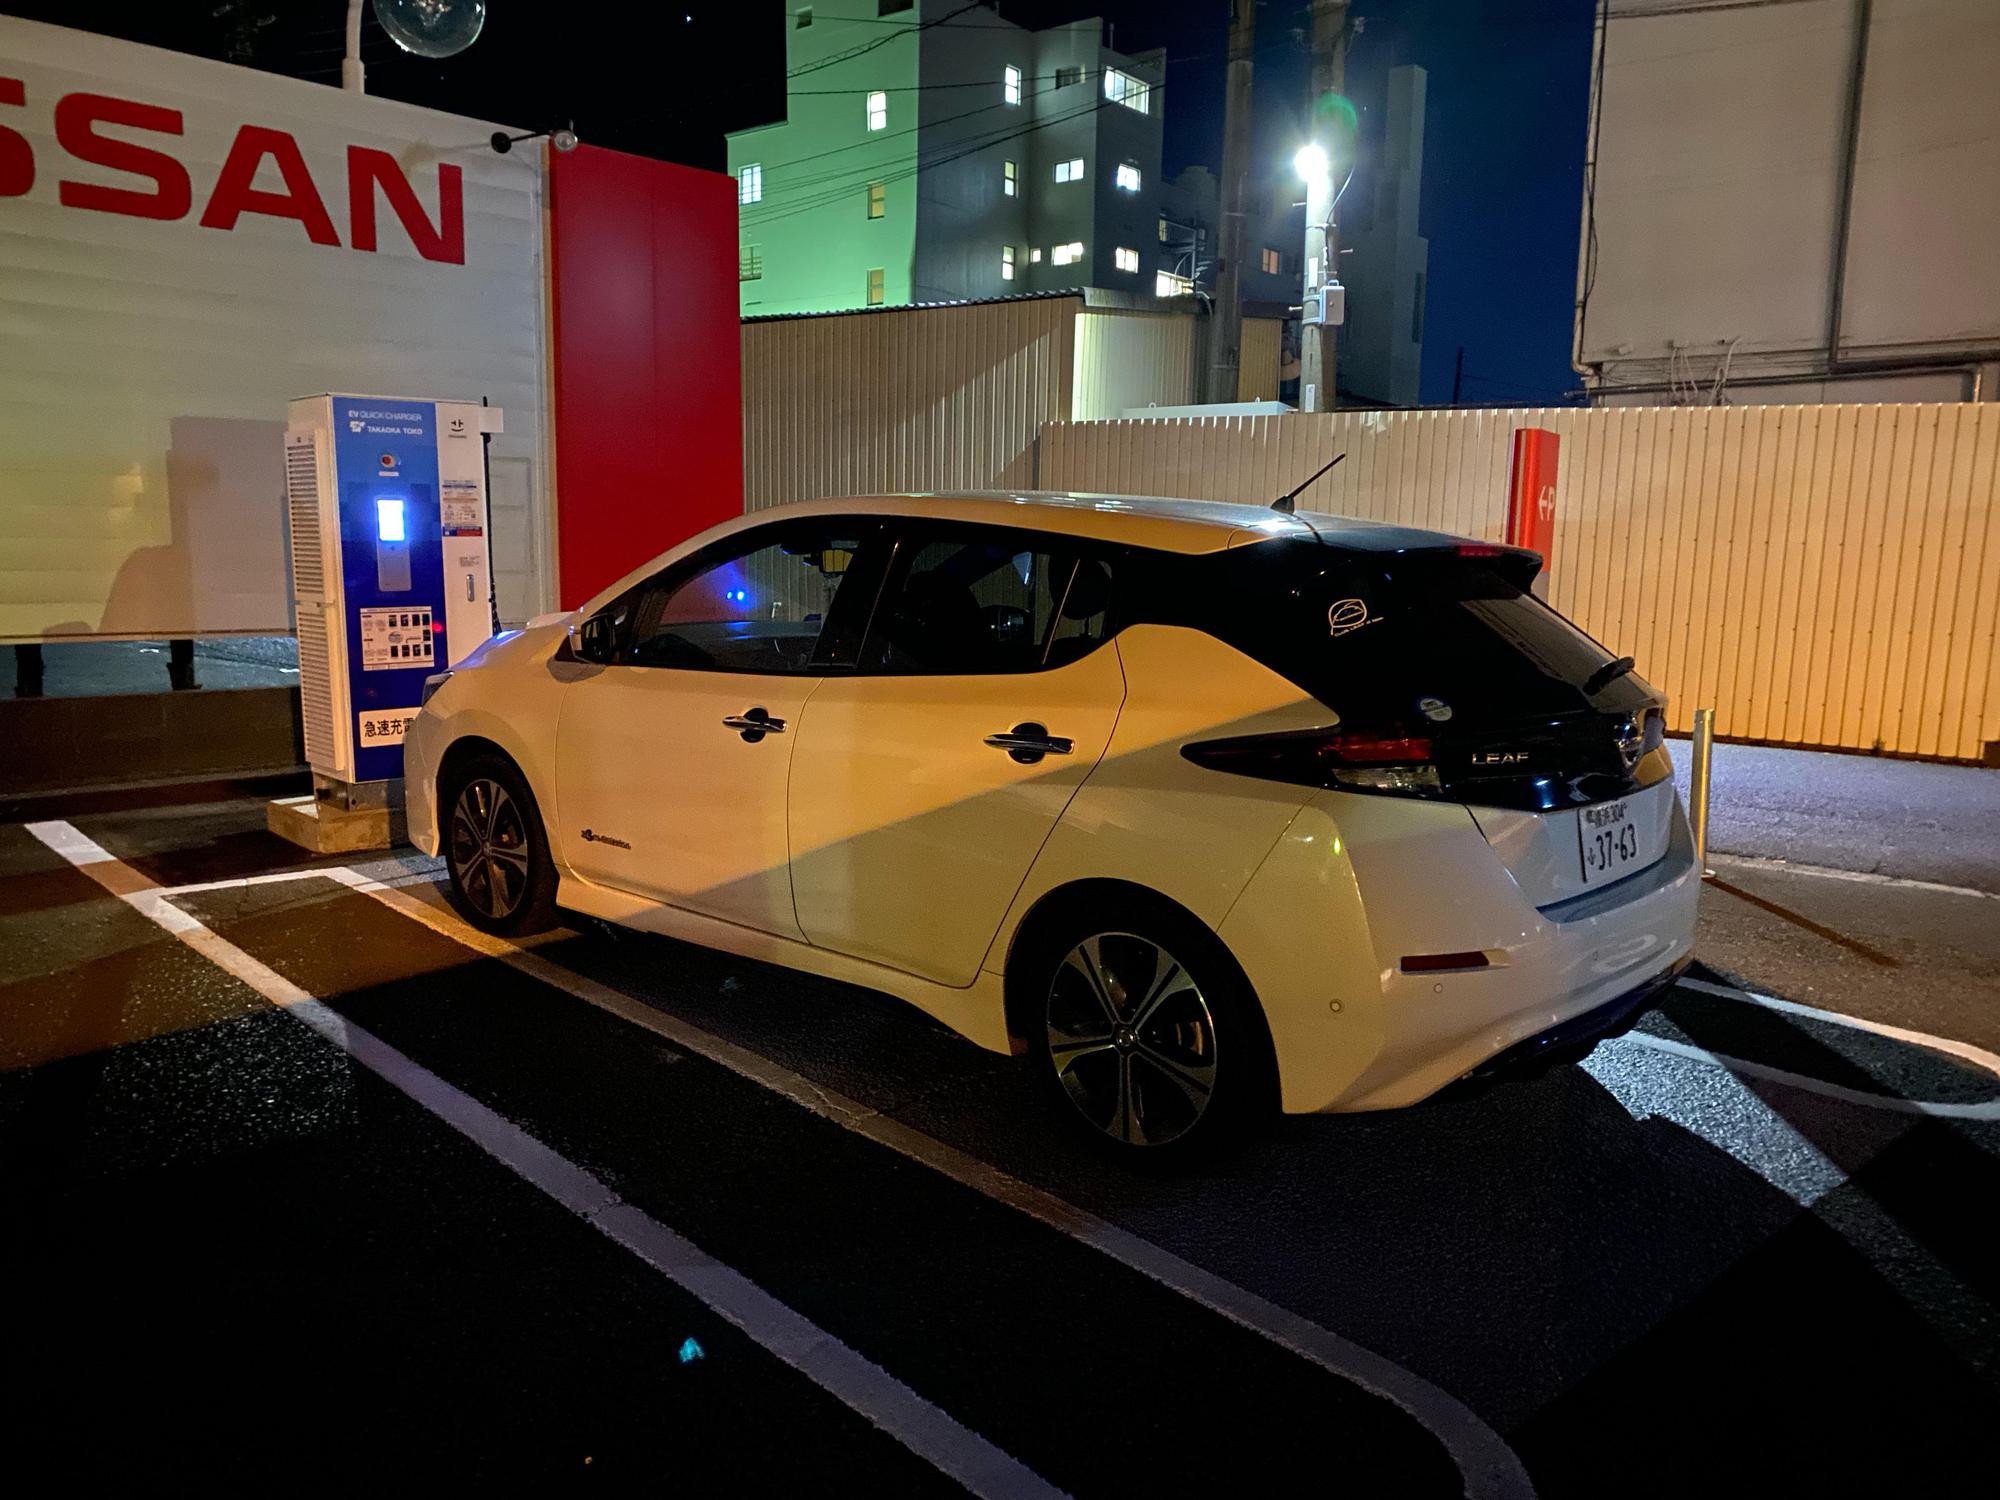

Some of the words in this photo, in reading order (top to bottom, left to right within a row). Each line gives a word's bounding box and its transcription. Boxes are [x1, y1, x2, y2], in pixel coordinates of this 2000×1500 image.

[0, 76, 465, 266] SAN
[348, 410, 359, 418] EV
[360, 411, 384, 419] QUICK
[385, 412, 422, 421] CHARGER
[367, 426, 401, 434] TAKAOKA
[402, 427, 423, 435] TOKO
[1471, 752, 1529, 765] LEAF
